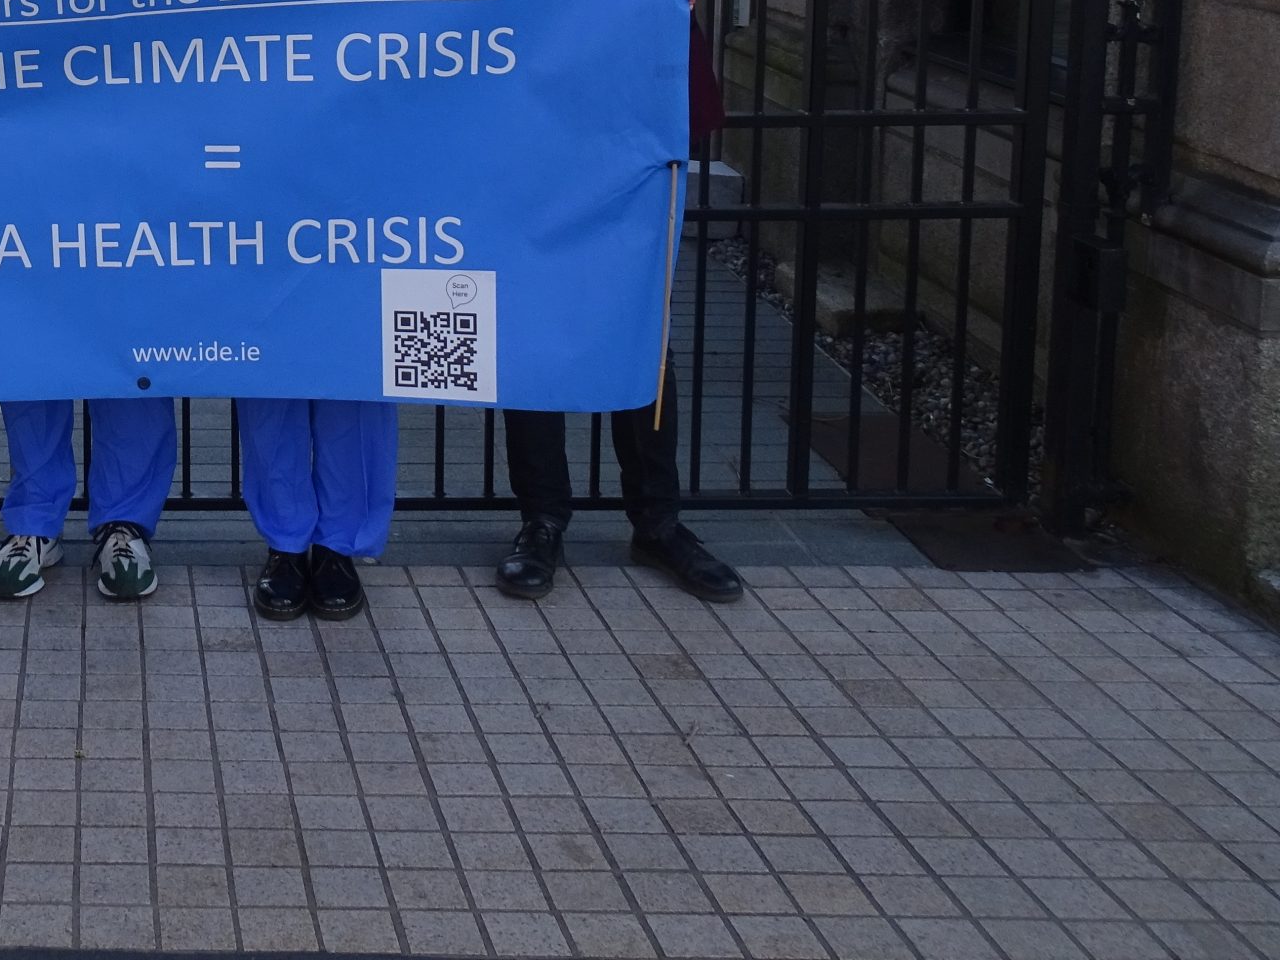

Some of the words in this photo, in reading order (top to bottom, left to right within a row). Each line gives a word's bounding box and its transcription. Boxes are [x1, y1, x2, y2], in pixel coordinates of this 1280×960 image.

[63, 33, 314, 86] CLIMATE
[335, 26, 517, 83] CRISIS
[51, 220, 264, 268] HEALTH
[286, 215, 465, 265] CRISIS
[132, 340, 261, 362] www.ide.ie
